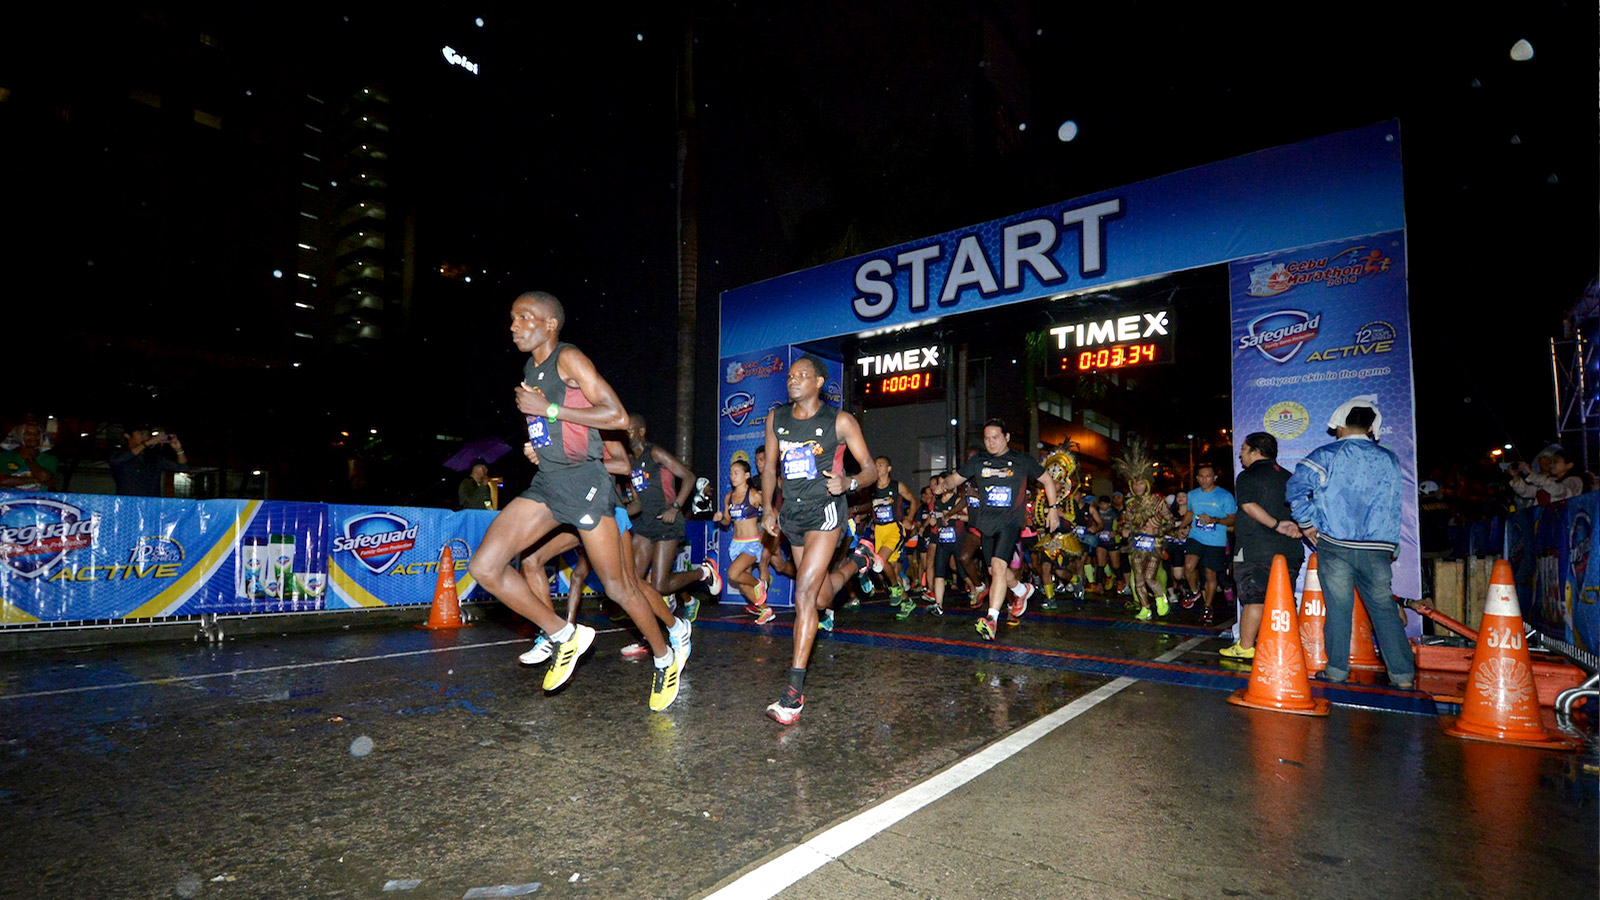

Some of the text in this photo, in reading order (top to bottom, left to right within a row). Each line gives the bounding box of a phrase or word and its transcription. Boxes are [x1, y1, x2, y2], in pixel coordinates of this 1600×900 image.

[852, 198, 1121, 319] START
[1287, 257, 1329, 273] Cebu
[1287, 264, 1362, 285] Marathon
[1049, 311, 1169, 350] TIMEX
[1238, 314, 1320, 349] Safeguard
[1355, 329, 1372, 344] 12
[857, 345, 939, 376] TIMEX
[1305, 340, 1395, 363] ACTIVE
[882, 373, 931, 392] 1:00:01
[1276, 375, 1302, 388] your
[1302, 372, 1326, 383] skin
[1326, 370, 1338, 381] in
[1339, 369, 1358, 379] the
[1358, 366, 1392, 379] game
[721, 396, 756, 416] Safeguard
[332, 524, 419, 553] Safeguard
[49, 562, 182, 582] ACTIVE
[389, 559, 470, 576] ACTIE
[1271, 609, 1291, 632] 59
